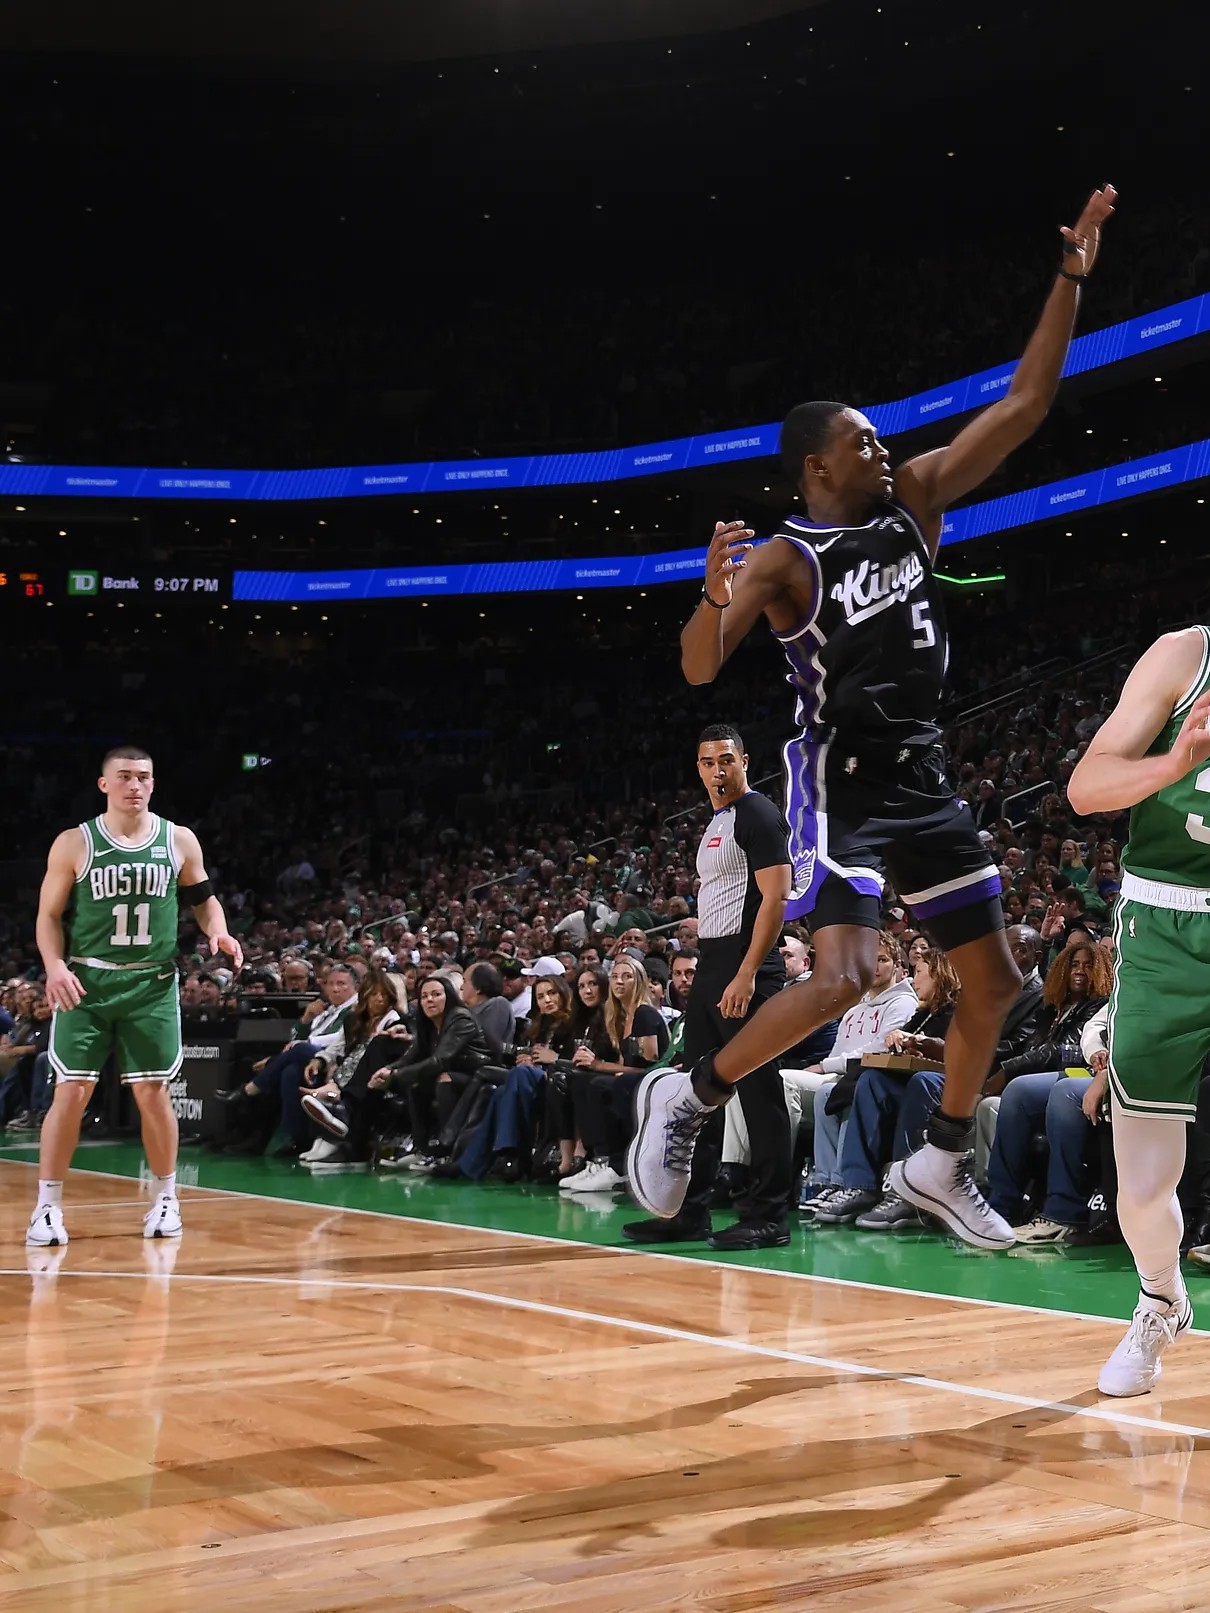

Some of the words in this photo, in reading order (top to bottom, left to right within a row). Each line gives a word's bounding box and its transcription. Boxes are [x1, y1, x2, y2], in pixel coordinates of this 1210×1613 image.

[1140, 318, 1183, 339] ticketmaster
[919, 396, 954, 414] ticketmaster
[633, 453, 673, 466] ticketmaster
[1116, 475, 1127, 487] LIVE
[1126, 472, 1139, 484] ONLY
[1138, 466, 1159, 481] HAPPENS
[1049, 488, 1087, 505] ticketmaster
[575, 568, 621, 578] ticketmaster
[72, 575, 95, 591] TD
[103, 577, 140, 590] Bank
[154, 578, 189, 592] 9:07
[193, 578, 219, 592] PM
[830, 551, 925, 626] Kings
[911, 600, 936, 649] 5
[89, 862, 172, 901] BOSTON
[109, 902, 153, 946] 11
